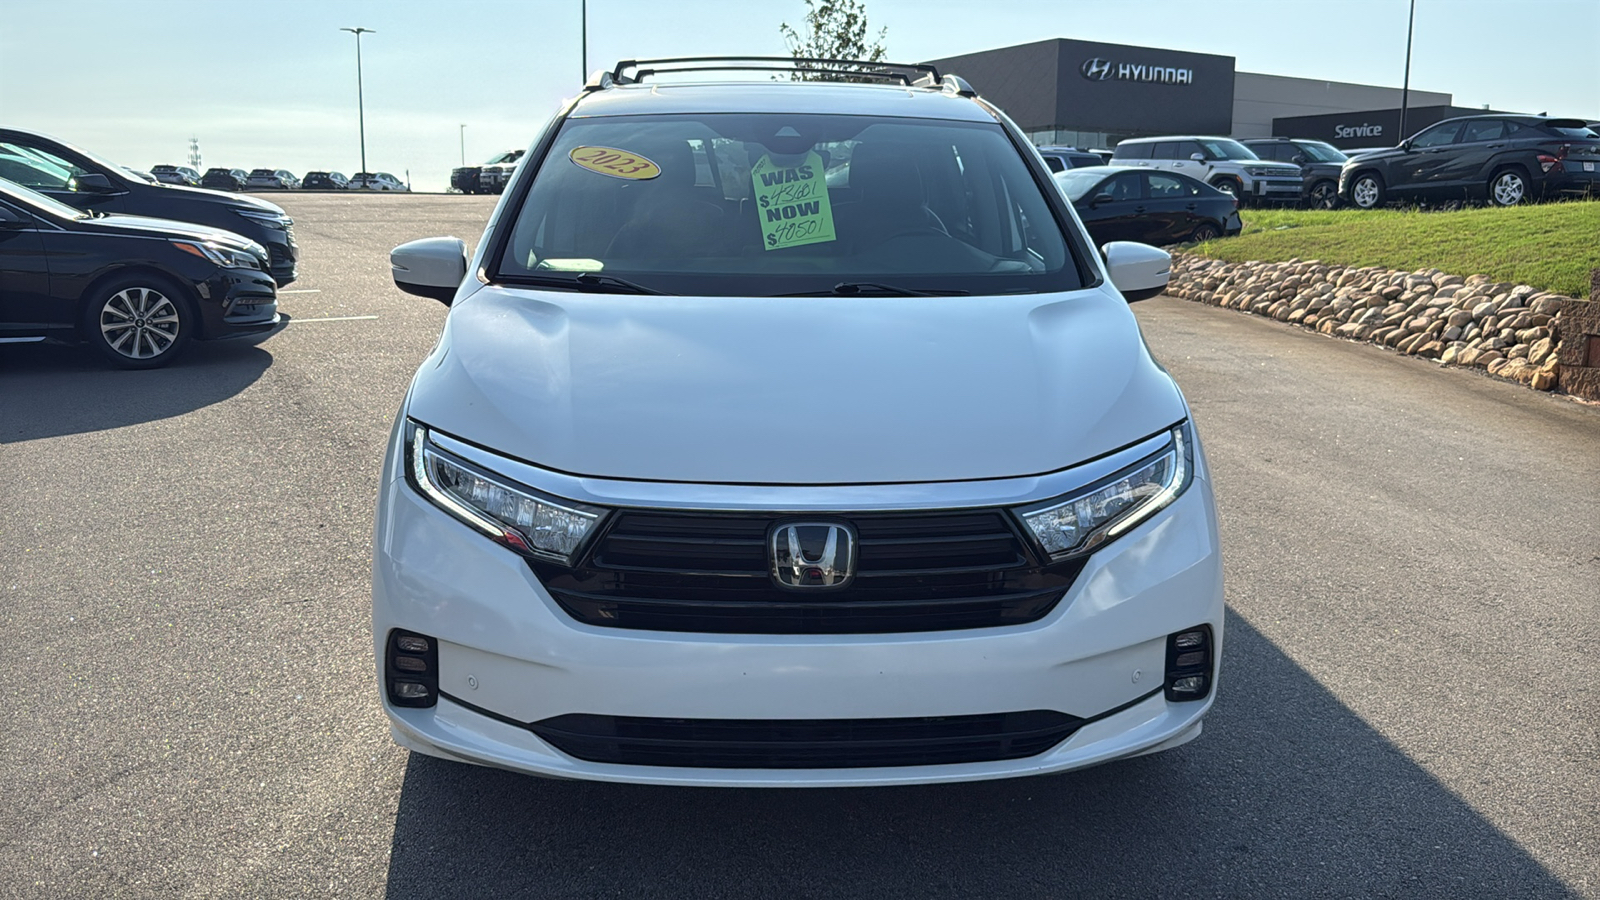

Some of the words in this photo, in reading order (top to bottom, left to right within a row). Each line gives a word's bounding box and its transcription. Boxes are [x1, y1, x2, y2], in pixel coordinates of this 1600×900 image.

[1118, 63, 1192, 84] HYUNDAI
[1334, 123, 1382, 138] Service
[576, 150, 650, 173] 2023
[760, 165, 814, 187] WAS
[766, 201, 820, 222] NOW
